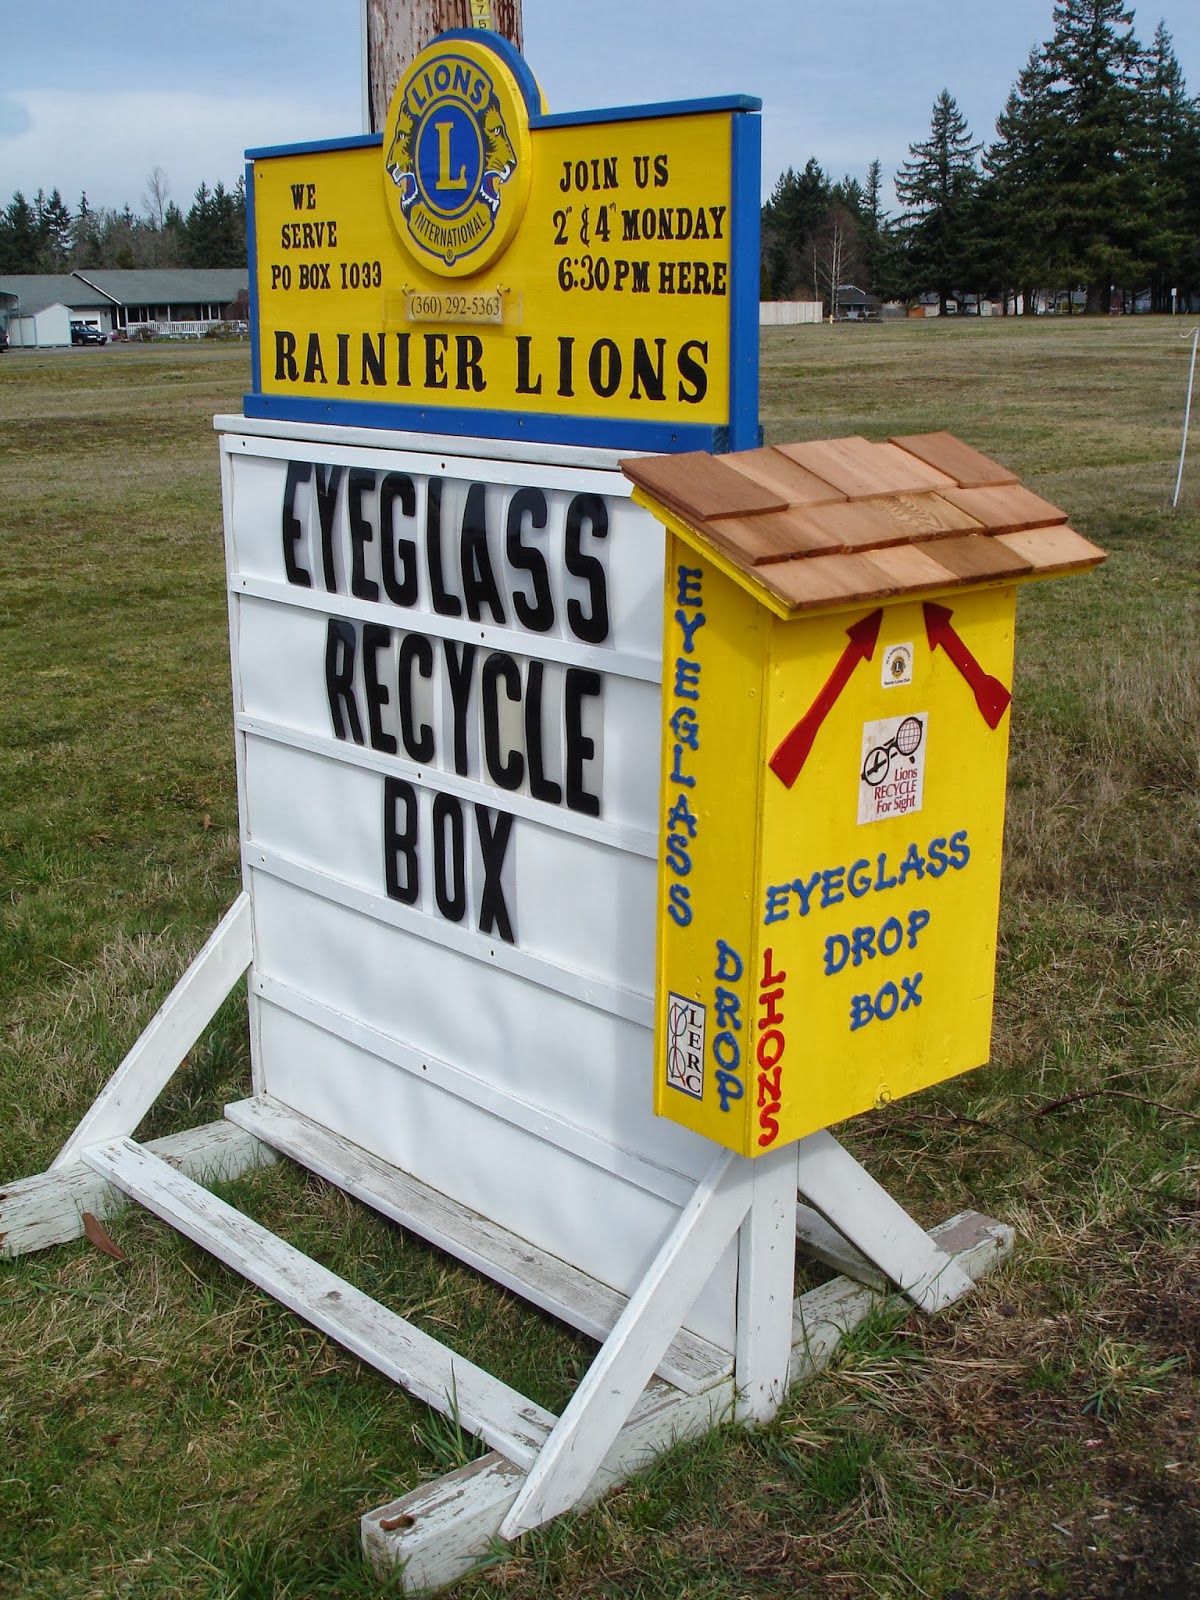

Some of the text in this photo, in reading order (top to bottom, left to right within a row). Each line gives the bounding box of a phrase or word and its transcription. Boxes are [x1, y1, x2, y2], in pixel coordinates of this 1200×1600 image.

[411, 64, 486, 110] LIONS
[435, 122, 467, 189] L
[560, 154, 669, 192] JOIN US
[290, 183, 316, 210] WE
[281, 221, 337, 249] SERVE
[414, 211, 487, 247] INTERNATIONAL
[621, 206, 726, 241] MONDAY
[271, 260, 382, 291] PO BOX 1033
[558, 254, 727, 296] 6:30 PM HERE
[410, 296, 500, 318] (360) 292-5363
[274, 331, 709, 403] RAINIER LIONS
[282, 460, 609, 643] EYEGLASS
[325, 617, 601, 816] RECYCLE
[666, 565, 706, 927] EYEGLASS
[874, 780, 917, 800] RECYCLE
[894, 767, 918, 781] Lions
[876, 794, 916, 814] For Sight
[384, 776, 514, 944] BOX
[764, 830, 970, 925] EYEGLASS
[824, 909, 930, 975] DROP
[850, 972, 923, 1031] BOX
[713, 939, 744, 1112] DROP
[757, 948, 786, 1147] LIONS
